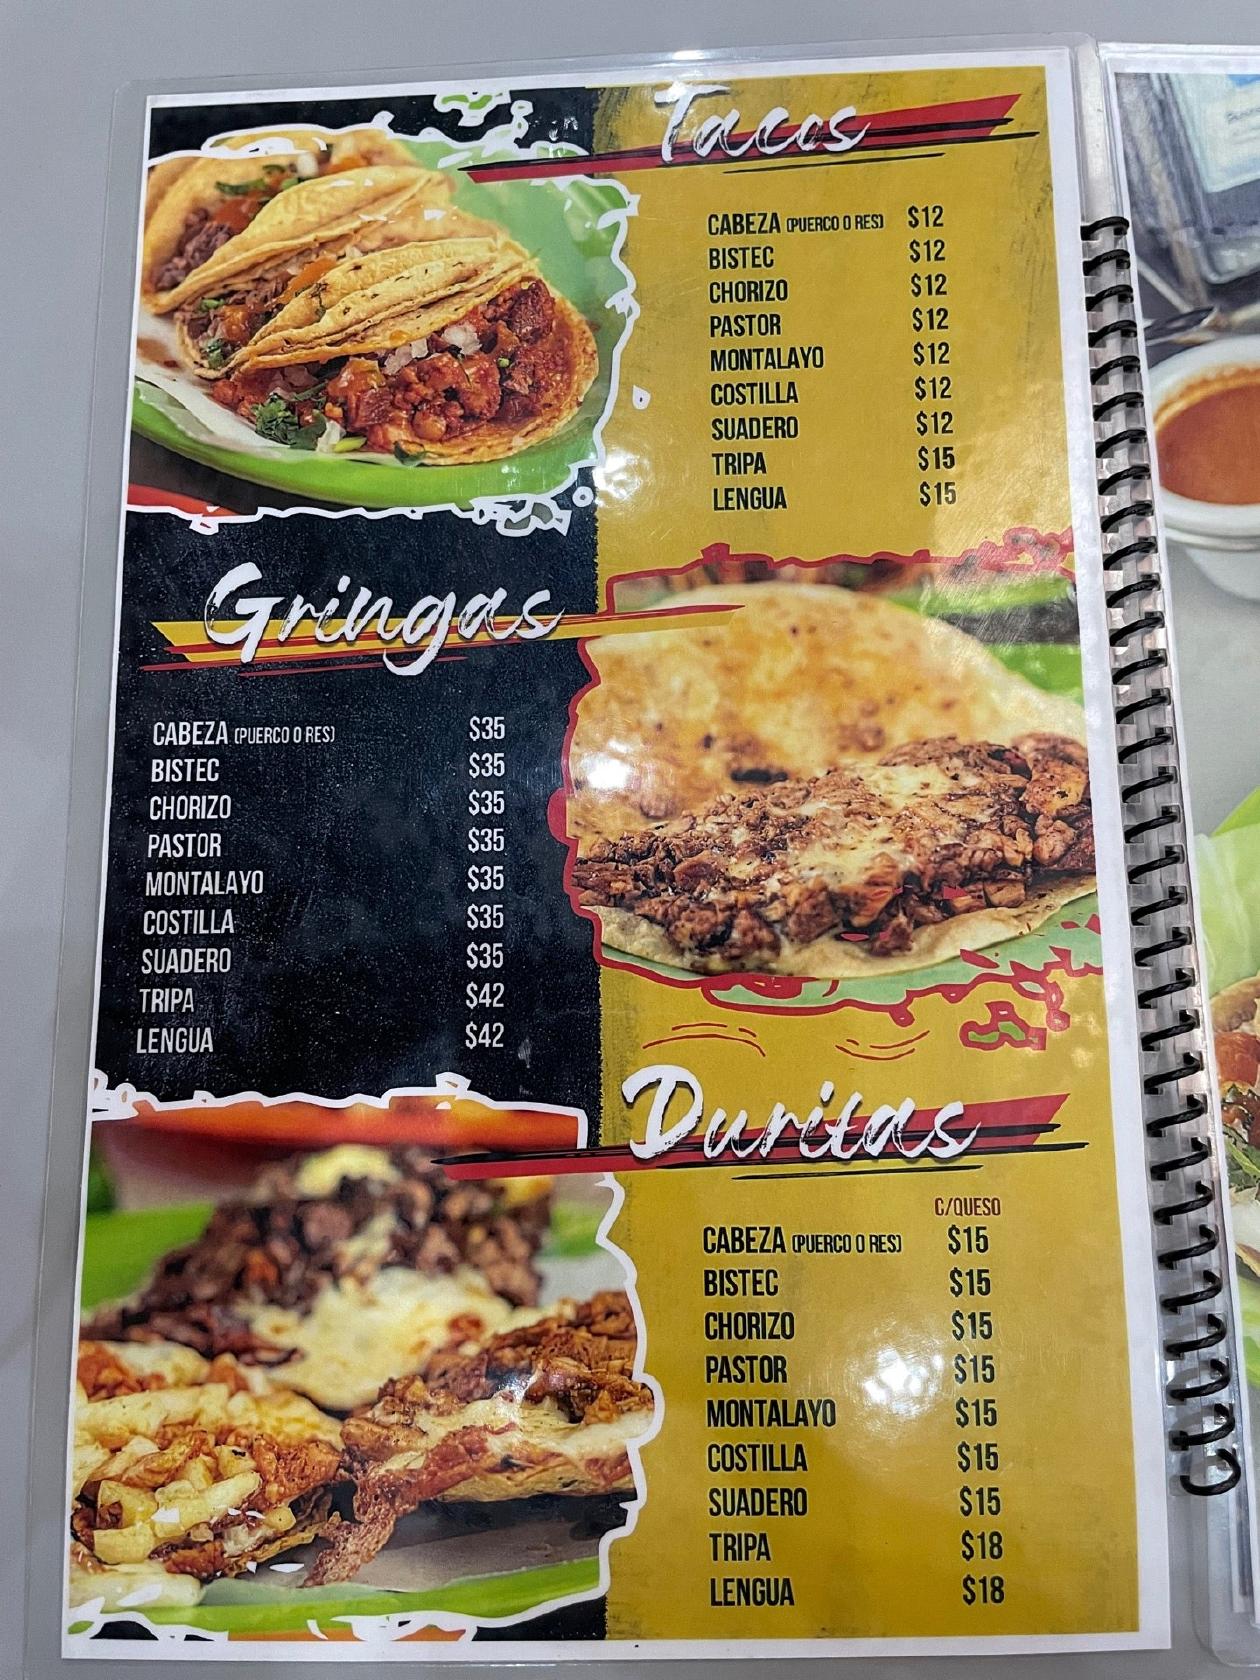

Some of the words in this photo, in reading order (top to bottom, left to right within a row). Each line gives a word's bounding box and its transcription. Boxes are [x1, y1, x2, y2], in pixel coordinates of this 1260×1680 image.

[654, 84, 871, 162] Tacos
[708, 213, 780, 235] CABEZA
[787, 216, 839, 232] (PUERCO
[843, 215, 851, 230] O
[855, 214, 883, 229] RES)
[908, 206, 943, 228] $12
[710, 246, 773, 269] BISTEC
[910, 240, 945, 263] $12
[710, 279, 787, 303] CHORIZO
[911, 273, 947, 297] $12
[711, 314, 780, 337] PASTOR
[913, 308, 948, 332] $12
[711, 346, 823, 371] MONTALAYO
[914, 342, 949, 366] $12
[711, 382, 798, 406] COSTILLA
[915, 376, 951, 401] $12
[712, 416, 798, 440] SUADERO
[917, 411, 953, 436] $12
[712, 452, 766, 475] TRIPA
[918, 446, 955, 471] $15
[714, 487, 787, 511] LENGUA
[920, 481, 956, 507] $15
[204, 562, 565, 675] Gringas
[153, 721, 228, 745] CABEZA
[235, 727, 289, 744] (PUERCO
[294, 727, 301, 743] O
[306, 726, 335, 742] RES)
[470, 716, 505, 741] $35
[152, 758, 219, 782] BISTEC
[469, 752, 505, 778] $35
[150, 795, 231, 820] CHORIZO
[469, 789, 504, 815] $35
[148, 833, 221, 857] PASTOR
[468, 827, 504, 853] $35
[146, 871, 263, 896] MONTALAYO
[468, 865, 504, 892] $35
[144, 909, 234, 935] COSTILLA
[467, 904, 503, 930] $35
[142, 948, 231, 974] SUADERO
[467, 942, 503, 969] $35
[140, 988, 194, 1012] TRIPA
[466, 982, 504, 1009] $42
[137, 1028, 213, 1053] LENGUA
[466, 1021, 504, 1049] $42
[623, 1064, 980, 1162] Duritas
[935, 1198, 1000, 1216] C/QUESO
[704, 1227, 786, 1253] CABEZA
[792, 1234, 851, 1253] (PUERCO
[856, 1234, 865, 1253] O
[869, 1235, 901, 1253] RES)
[948, 1225, 988, 1254] $15
[704, 1270, 778, 1296] BISTEC
[950, 1267, 990, 1297] $15
[705, 1312, 794, 1340] CHORIZO
[952, 1310, 992, 1340] $15
[706, 1355, 787, 1383] PASTOR
[955, 1354, 994, 1384] $15
[707, 1399, 835, 1427] MONTALAYO
[956, 1397, 997, 1428] $15
[708, 1444, 808, 1472] COSTILLA
[958, 1441, 998, 1472] $15
[709, 1488, 807, 1516] SUADERO
[960, 1486, 1000, 1516] $15
[709, 1533, 771, 1561] TRIPA
[962, 1530, 1002, 1561] $18
[711, 1578, 794, 1606] LENGUA
[963, 1575, 1004, 1605] $18
